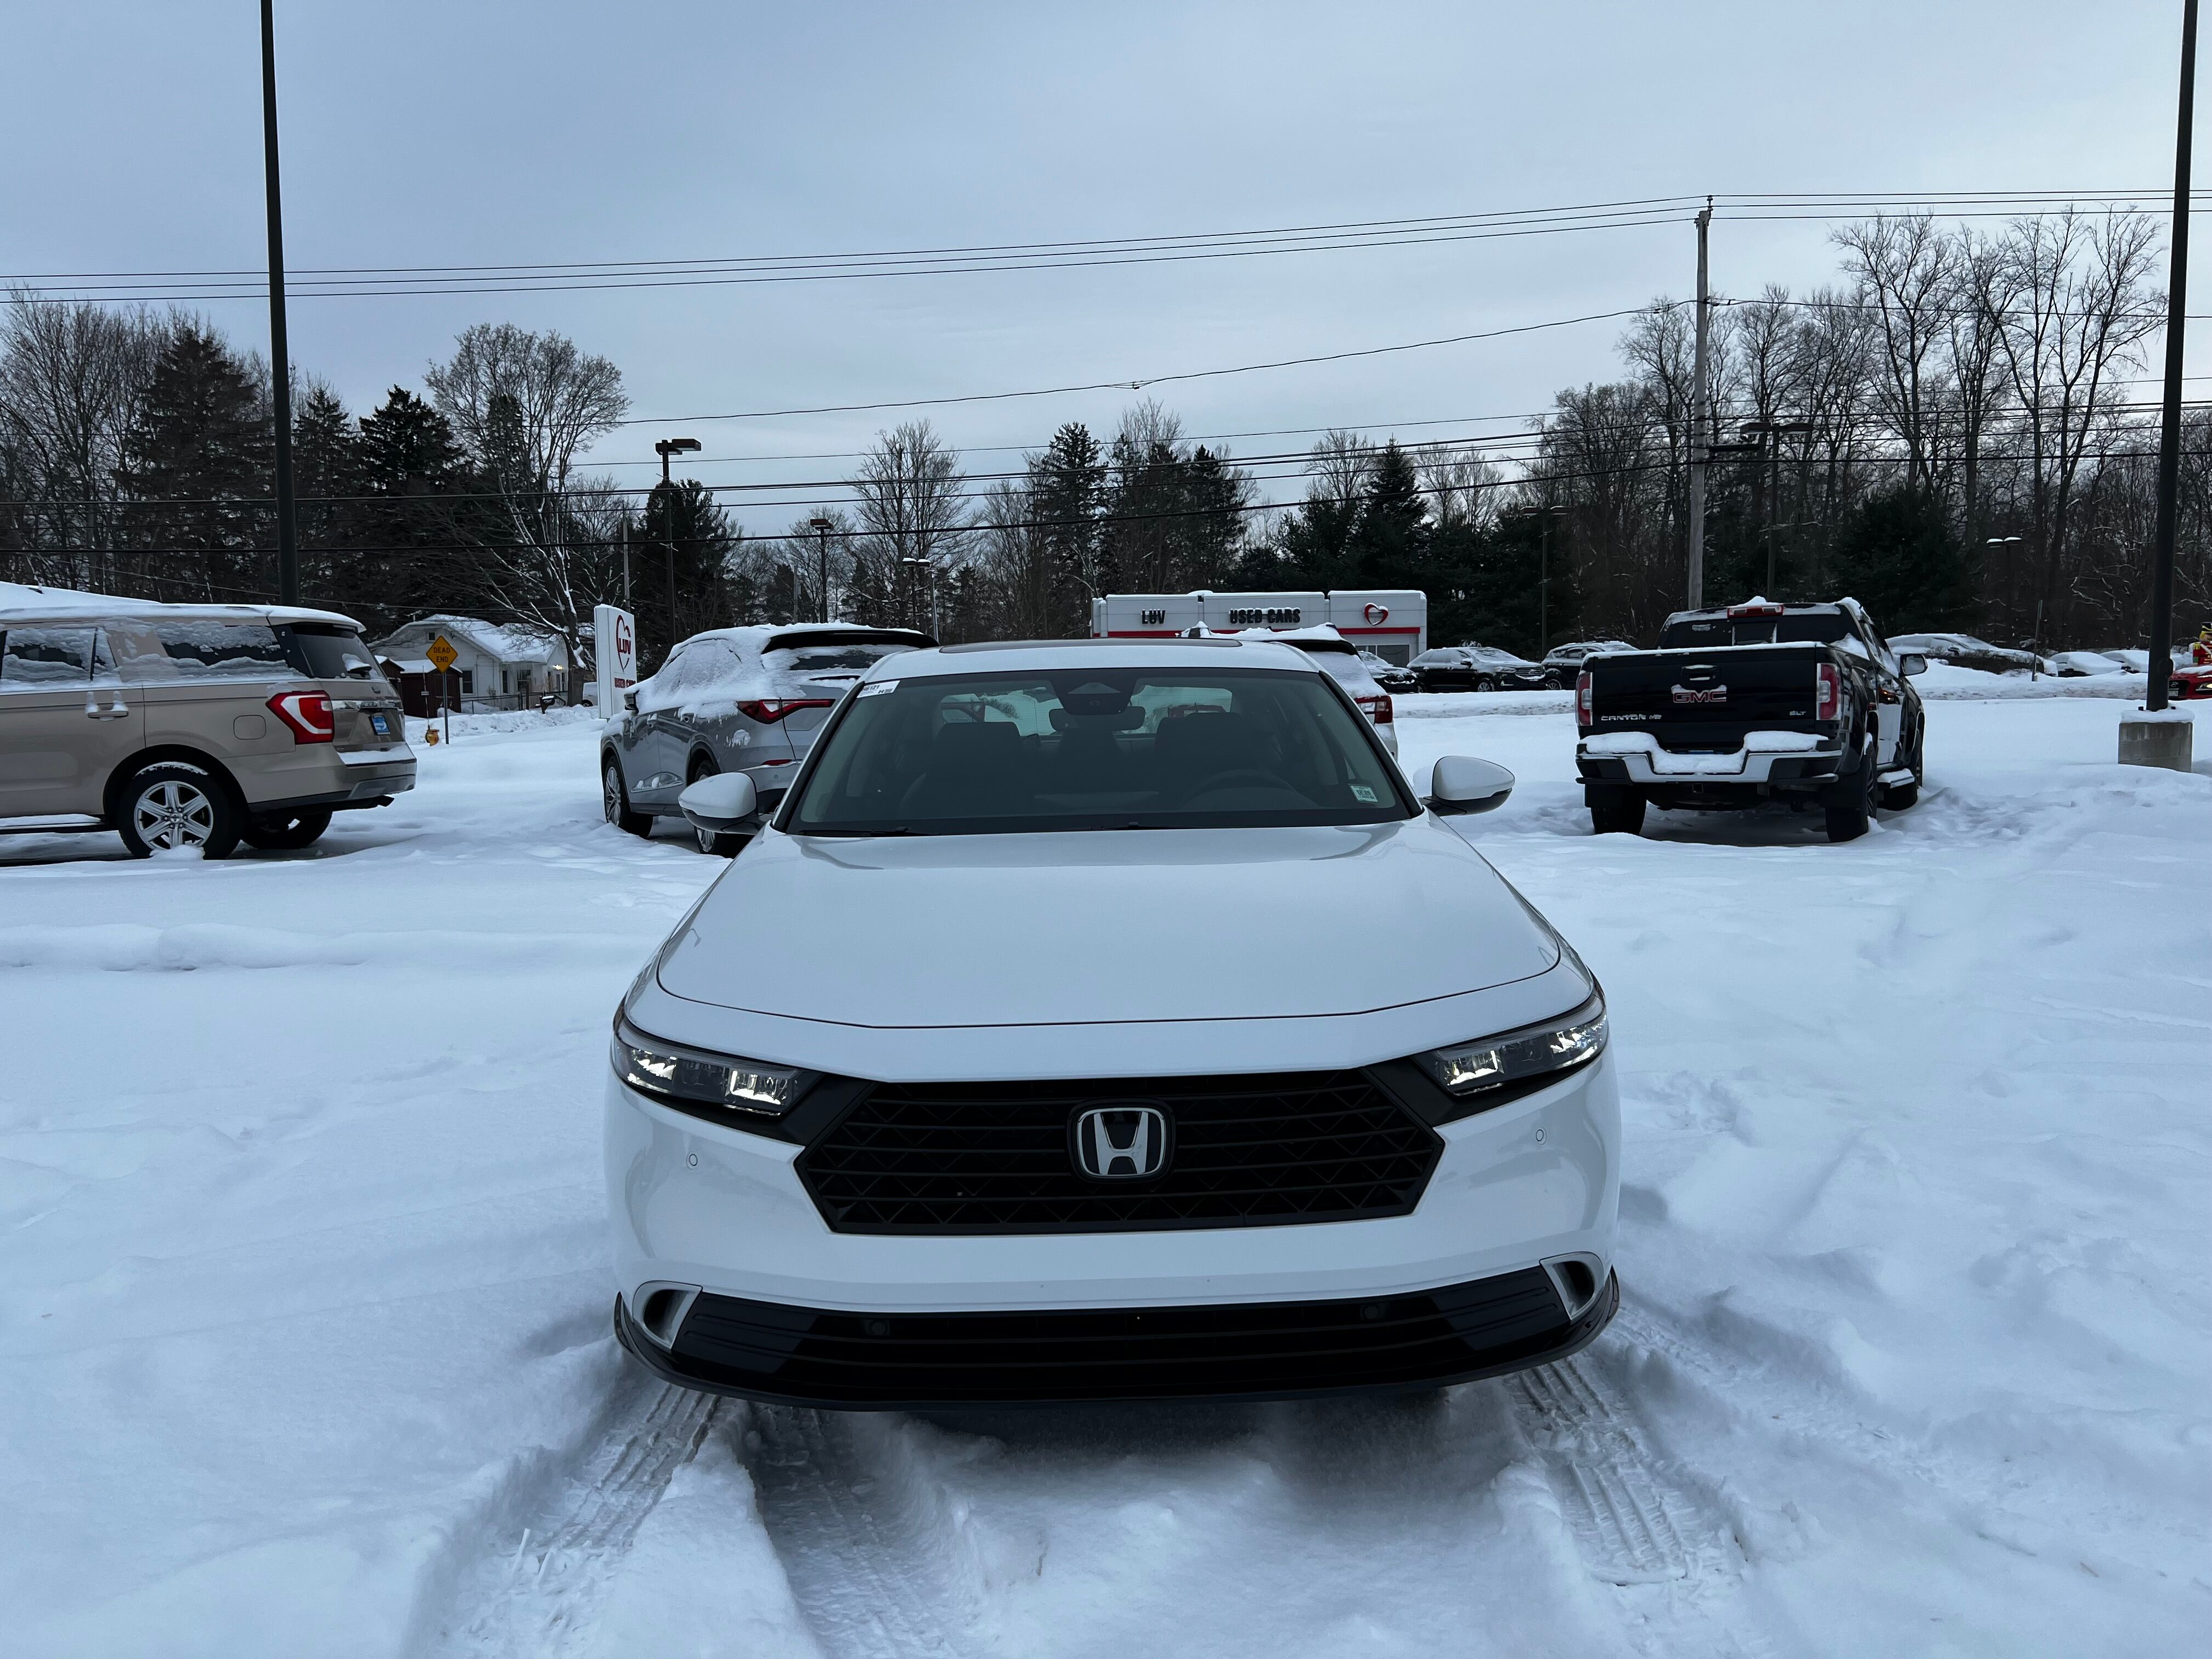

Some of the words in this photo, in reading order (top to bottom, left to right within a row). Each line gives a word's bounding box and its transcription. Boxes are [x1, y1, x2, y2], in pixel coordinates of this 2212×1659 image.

[1142, 610, 1166, 624] LUV
[1230, 609, 1262, 624] USED
[1267, 608, 1301, 623] CARS
[619, 637, 631, 654] LUV
[614, 678, 625, 688] USED
[1673, 690, 1727, 703] GMC
